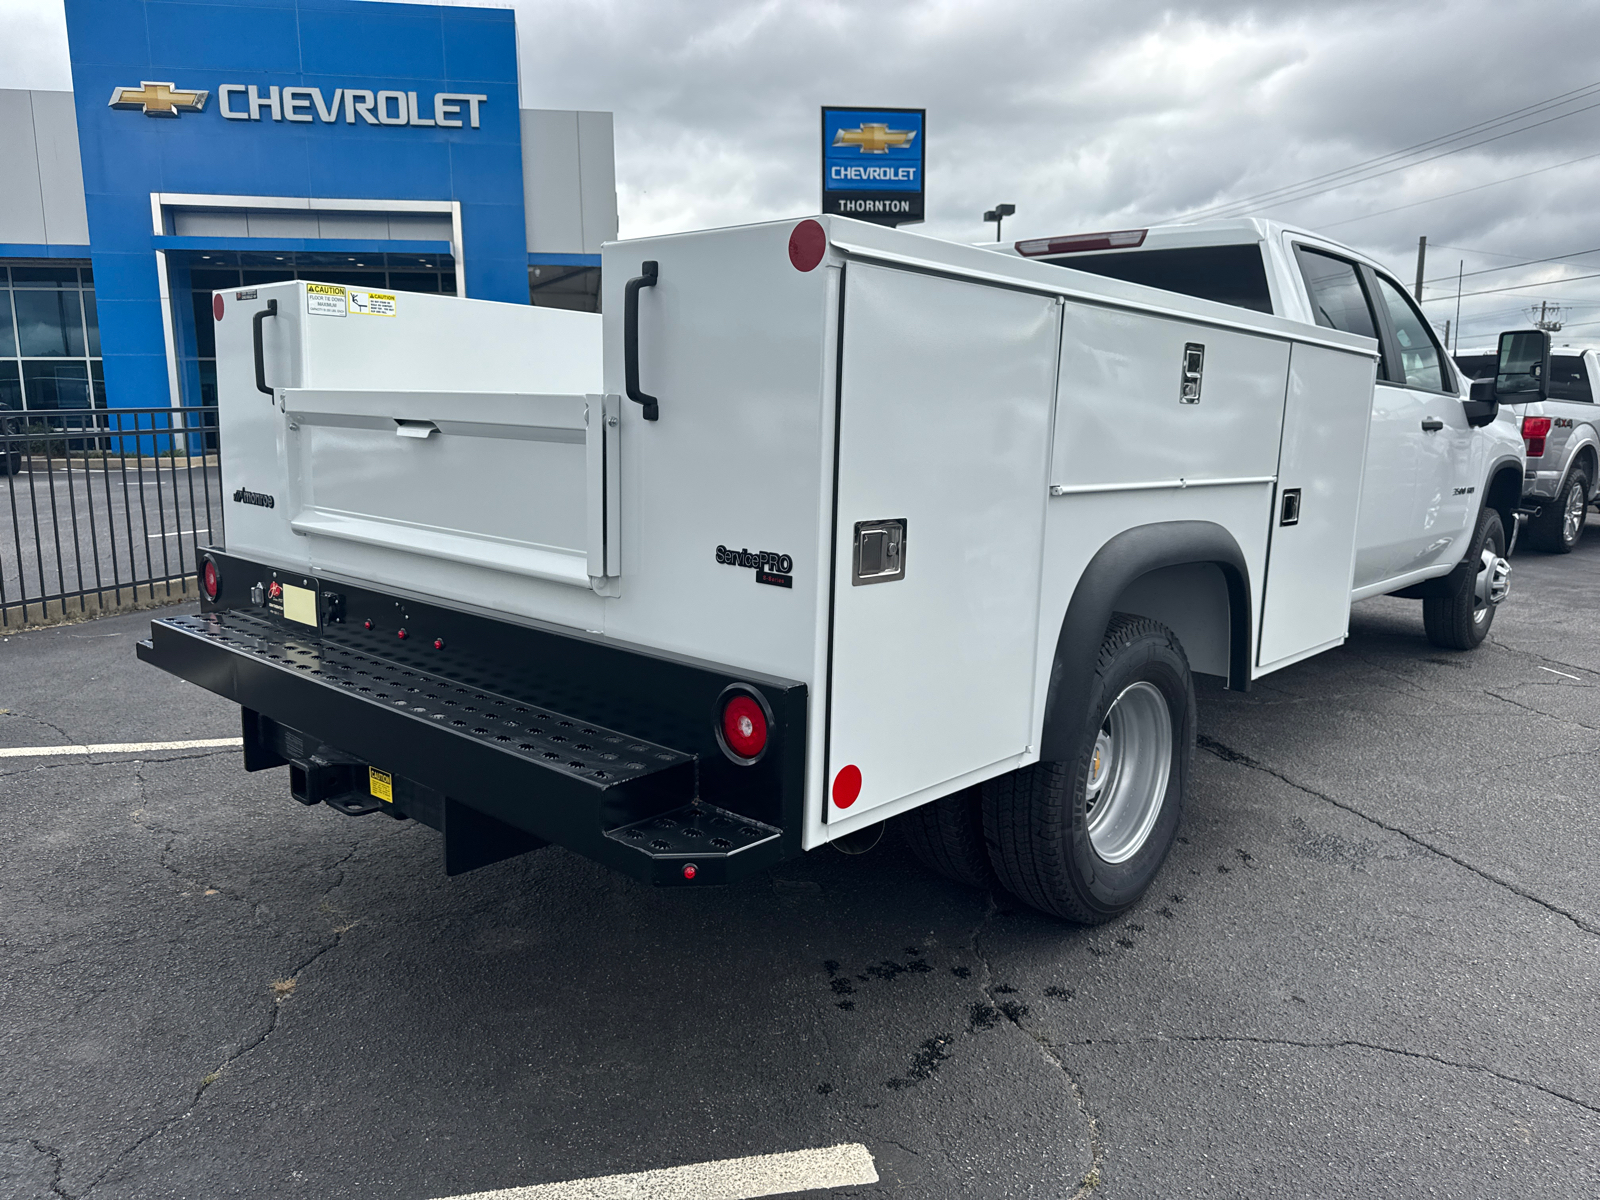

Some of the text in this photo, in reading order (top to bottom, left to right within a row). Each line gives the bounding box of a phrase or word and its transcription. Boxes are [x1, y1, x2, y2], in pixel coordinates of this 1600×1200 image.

[218, 84, 488, 128] CHEVROLET
[831, 166, 917, 181] CHEVROLET
[838, 199, 910, 212] THORNTON
[314, 285, 345, 295] CAUTION
[374, 293, 395, 301] CAUTION
[716, 545, 792, 574] ServicePRO
[371, 770, 391, 784] CAUTION
